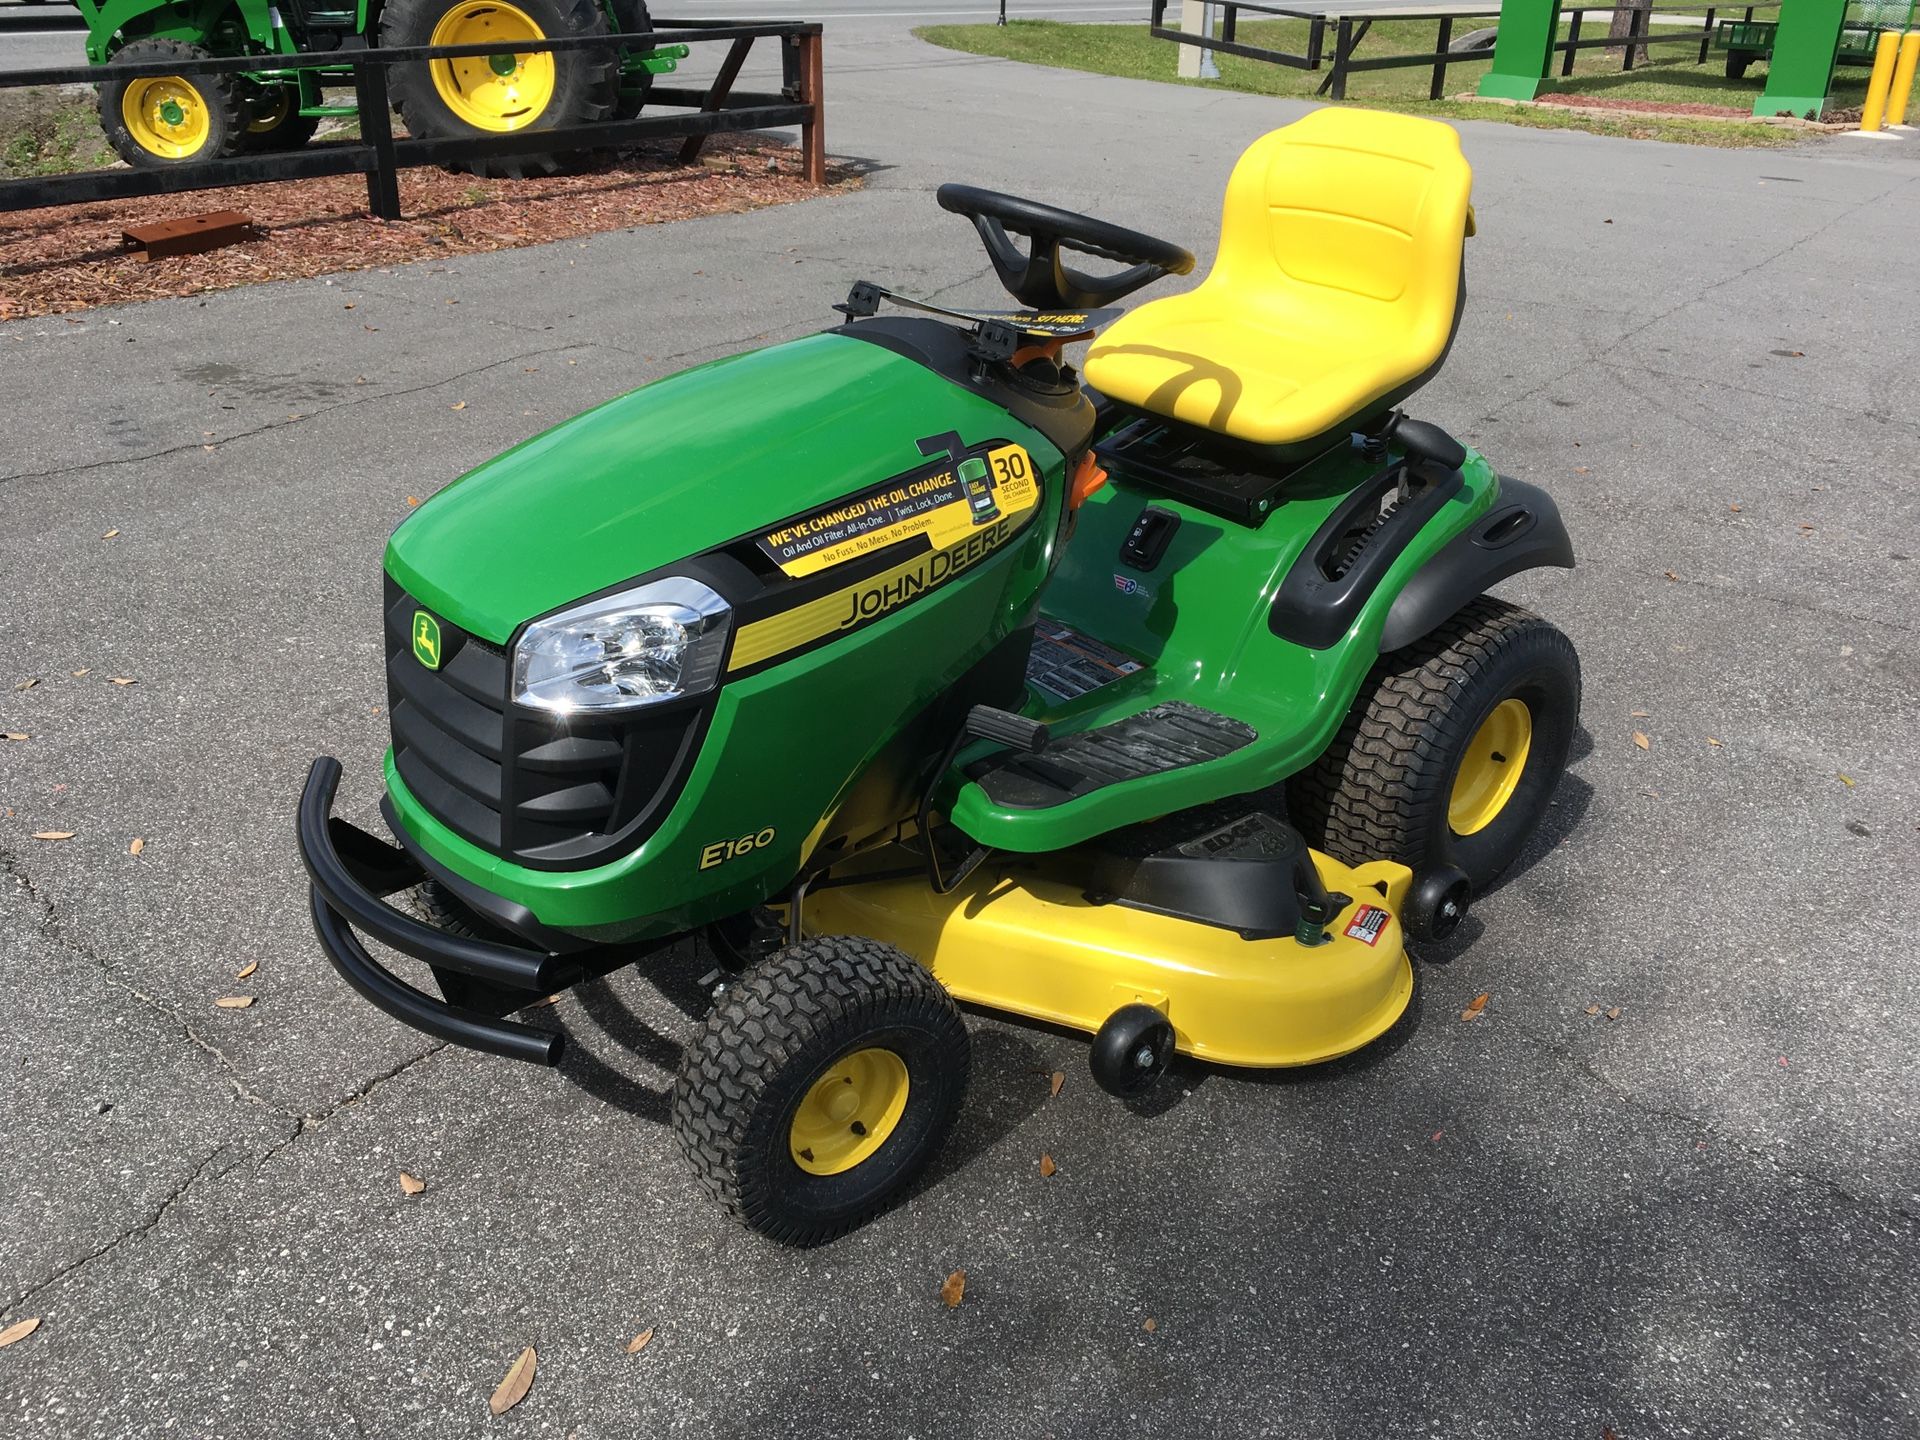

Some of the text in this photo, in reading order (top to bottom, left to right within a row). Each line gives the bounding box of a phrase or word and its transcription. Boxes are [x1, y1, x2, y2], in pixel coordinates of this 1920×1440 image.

[994, 453, 1025, 485] 30
[1001, 478, 1030, 494] SECOND
[767, 472, 957, 548] WE'VE CHANGED THE OIL CHANGE.
[1003, 486, 1031, 500] OIL CHANGE
[782, 490, 955, 558] Oil And Oil Filter, All-In-One. Twist. Lock. Done.
[822, 553, 836, 563] No
[836, 547, 857, 560] Fuss.
[856, 540, 869, 551] No
[868, 532, 890, 547] Mess.
[890, 528, 904, 539] No
[902, 517, 935, 534] Problem.
[841, 522, 1011, 627] JOHN DEERE
[699, 827, 776, 870] E160
